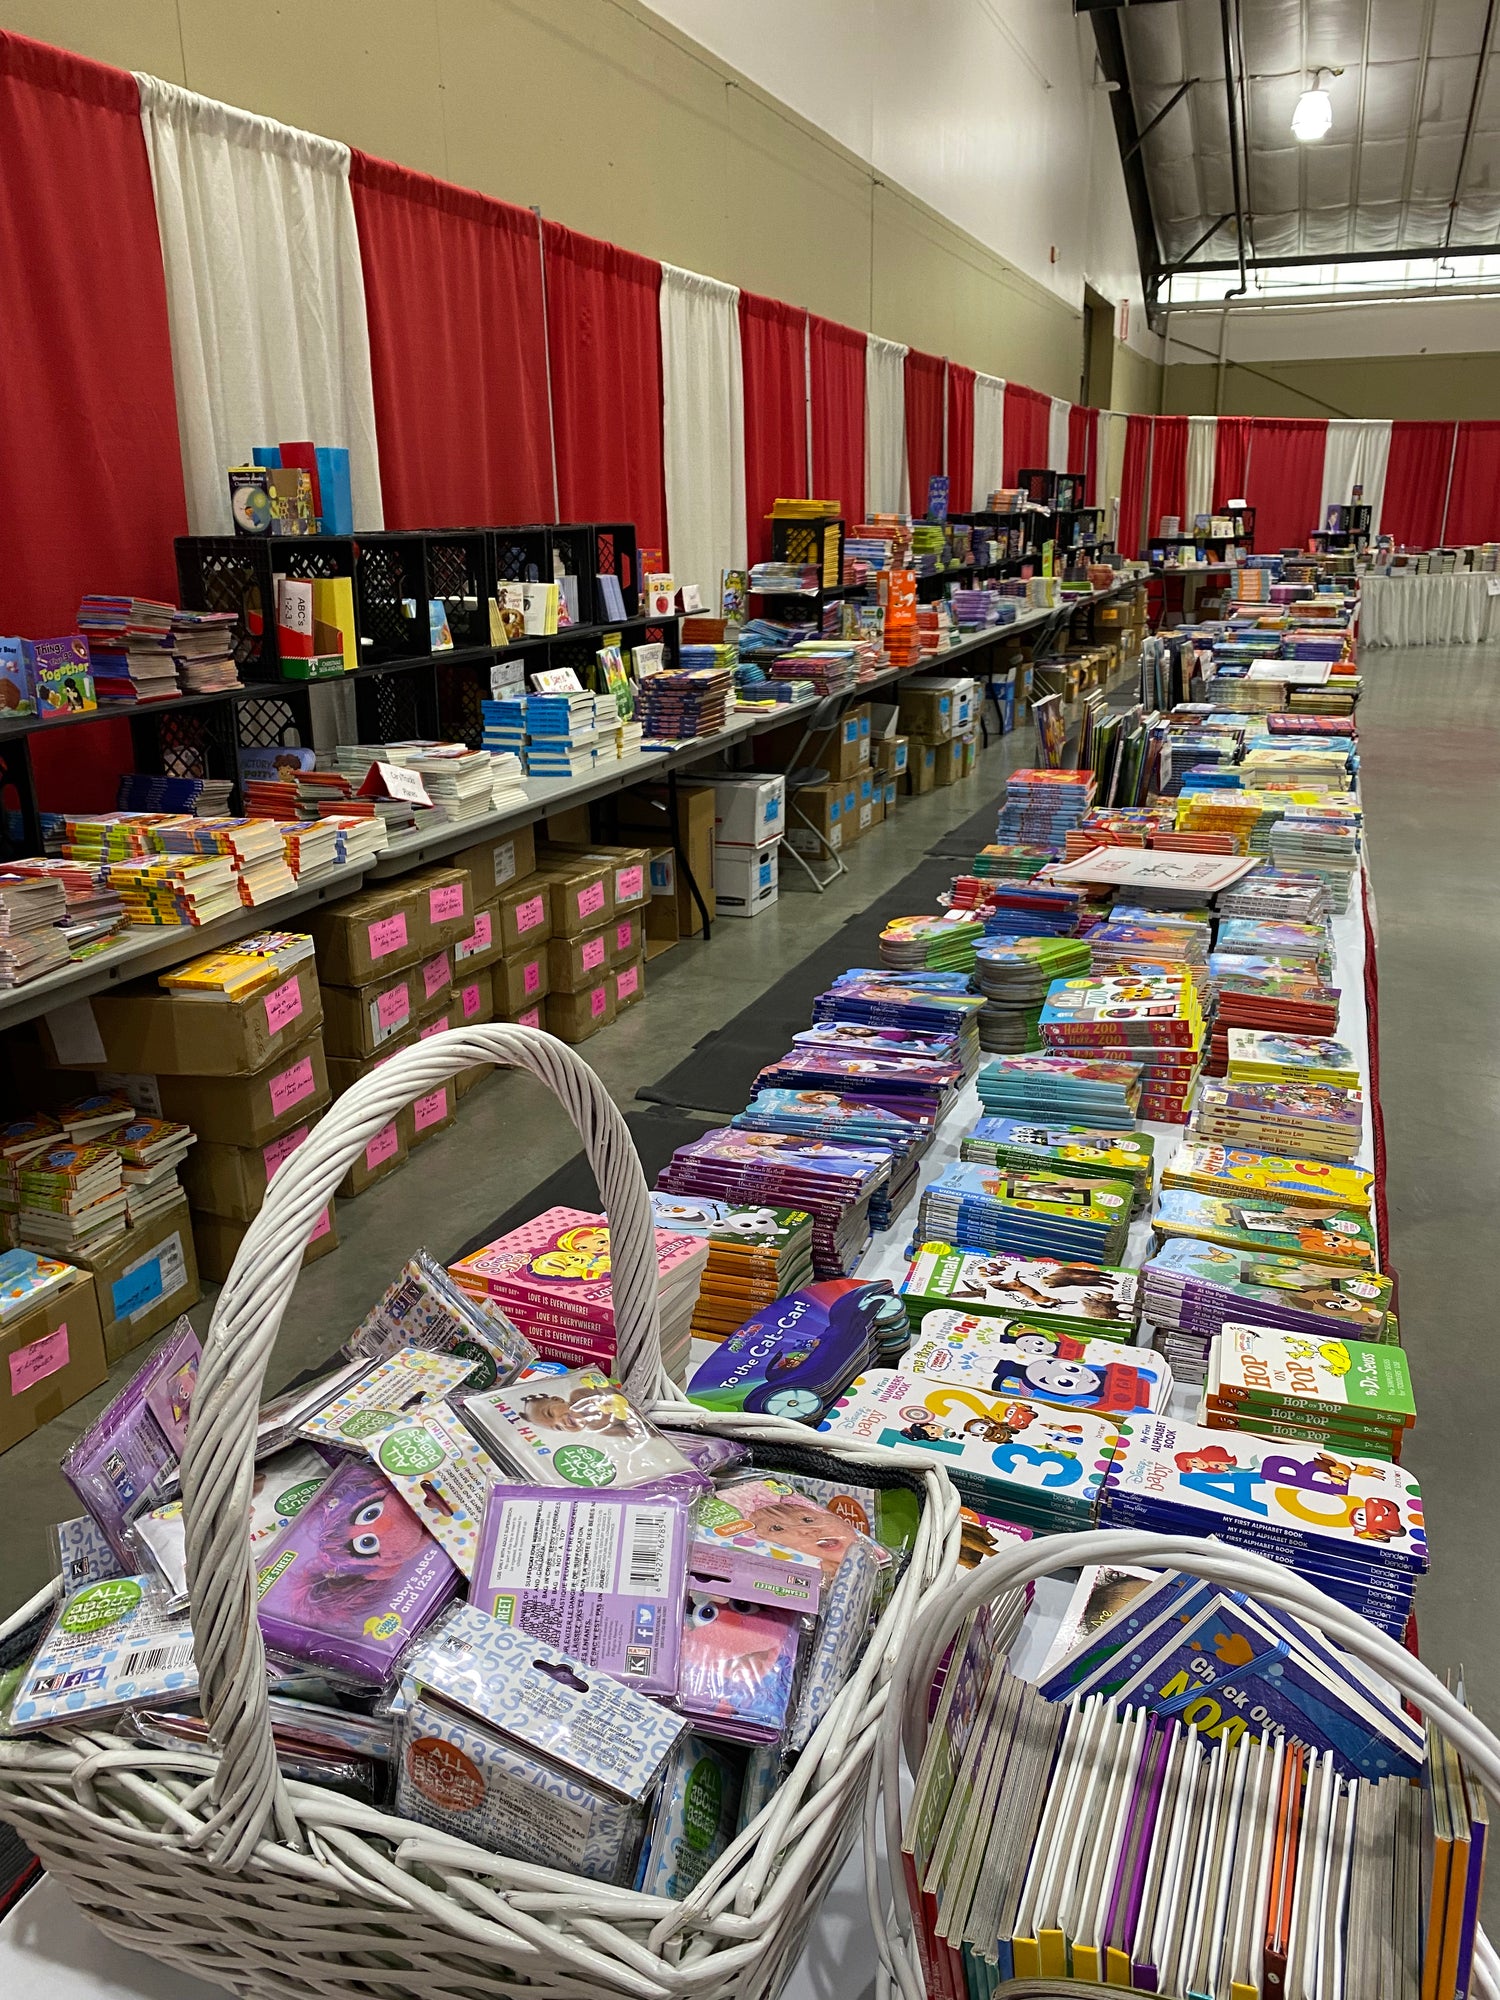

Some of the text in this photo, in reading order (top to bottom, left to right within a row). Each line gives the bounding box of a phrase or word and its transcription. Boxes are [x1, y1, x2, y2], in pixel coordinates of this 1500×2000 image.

[35, 643, 65, 656] Things
[39, 661, 90, 683] Together
[1092, 1023, 1118, 1034] ZOO
[1011, 1145, 1034, 1153] BOOK
[1294, 1163, 1330, 1177] c
[938, 1188, 1003, 1205] VIDEO FUN BOOK
[753, 1247, 774, 1256] bendon
[958, 1249, 988, 1258] ocean
[995, 1253, 1022, 1263] night
[930, 1255, 962, 1295] Animals
[1030, 1266, 1048, 1279] bear
[1155, 1269, 1233, 1293] VIDEO FUN BOOK
[493, 1284, 590, 1316] SUNNY LOVE IS EVERYWHERE!
[535, 1311, 550, 1322] LOVE
[550, 1315, 557, 1324] IS
[557, 1317, 602, 1332] EVERYWHERE!
[947, 1314, 982, 1350] COLORS
[528, 1325, 594, 1348] LOVE IS EVERYWHERE!
[719, 1300, 813, 1391] To the Cat-Car!
[544, 1347, 585, 1365] EVERYWHERE!
[1361, 1352, 1379, 1375] Seuss
[532, 1365, 560, 1375] ready
[1240, 1354, 1273, 1390] HOP
[1273, 1369, 1287, 1382] ON
[1285, 1360, 1320, 1394] POP
[871, 1376, 891, 1397] My First
[877, 1374, 906, 1404] NUMBERS
[893, 1381, 913, 1401] BOOK
[1360, 1373, 1379, 1390] Dr.
[1282, 1396, 1342, 1414] HOP POP
[488, 1396, 552, 1456] BATH TIME
[852, 1406, 889, 1439] baby
[1271, 1408, 1329, 1426] HOP POP
[876, 1388, 1084, 1488] 1 2 3
[1140, 1424, 1152, 1445] My First
[1150, 1420, 1167, 1453] ALPHABET
[1163, 1428, 1177, 1450] BOOK
[1272, 1425, 1331, 1442] HOP POP
[392, 1431, 430, 1470] aBOUT
[406, 1426, 441, 1464] BaBies
[440, 1437, 461, 1459] BATH
[383, 1444, 410, 1471] ALL
[560, 1457, 585, 1479] ALL
[1144, 1461, 1174, 1493] baby
[1052, 1492, 1080, 1506] bendon
[1178, 1454, 1366, 1528] A B C
[835, 1502, 859, 1519] ALL
[1050, 1501, 1077, 1513] bendon
[558, 1527, 566, 1542] TOY
[657, 1524, 667, 1550] 66785
[1222, 1515, 1304, 1539] MY FIRST ALPHABET BOOK
[1227, 1525, 1309, 1548] MY FIRST ALPHABET BOOK
[1214, 1531, 1295, 1555] MY FIRST ALPHABET BOOK
[273, 1552, 294, 1580] STREET
[554, 1553, 563, 1568] NOT
[1275, 1555, 1295, 1565] BOOK
[1379, 1549, 1409, 1562] bendon
[1384, 1559, 1414, 1571] bendon
[554, 1569, 561, 1577] IS
[561, 1552, 572, 1581] PEUVENT
[655, 1552, 665, 1583] 39277
[1370, 1566, 1400, 1579] bendon
[389, 1548, 439, 1611] Abby's ABCs
[550, 1580, 559, 1595] BAG
[754, 1581, 807, 1598] SESAME STREET
[1369, 1577, 1399, 1590] bendon
[88, 1585, 126, 1599] ALL
[400, 1568, 436, 1614] and 123s
[1367, 1589, 1397, 1602] bendon
[1361, 1606, 1391, 1620] bendon
[1366, 1598, 1396, 1611] bendon
[1189, 1656, 1288, 1739] Chck Out
[427, 1745, 471, 1775] ALL
[921, 1765, 946, 1837] SEEK
